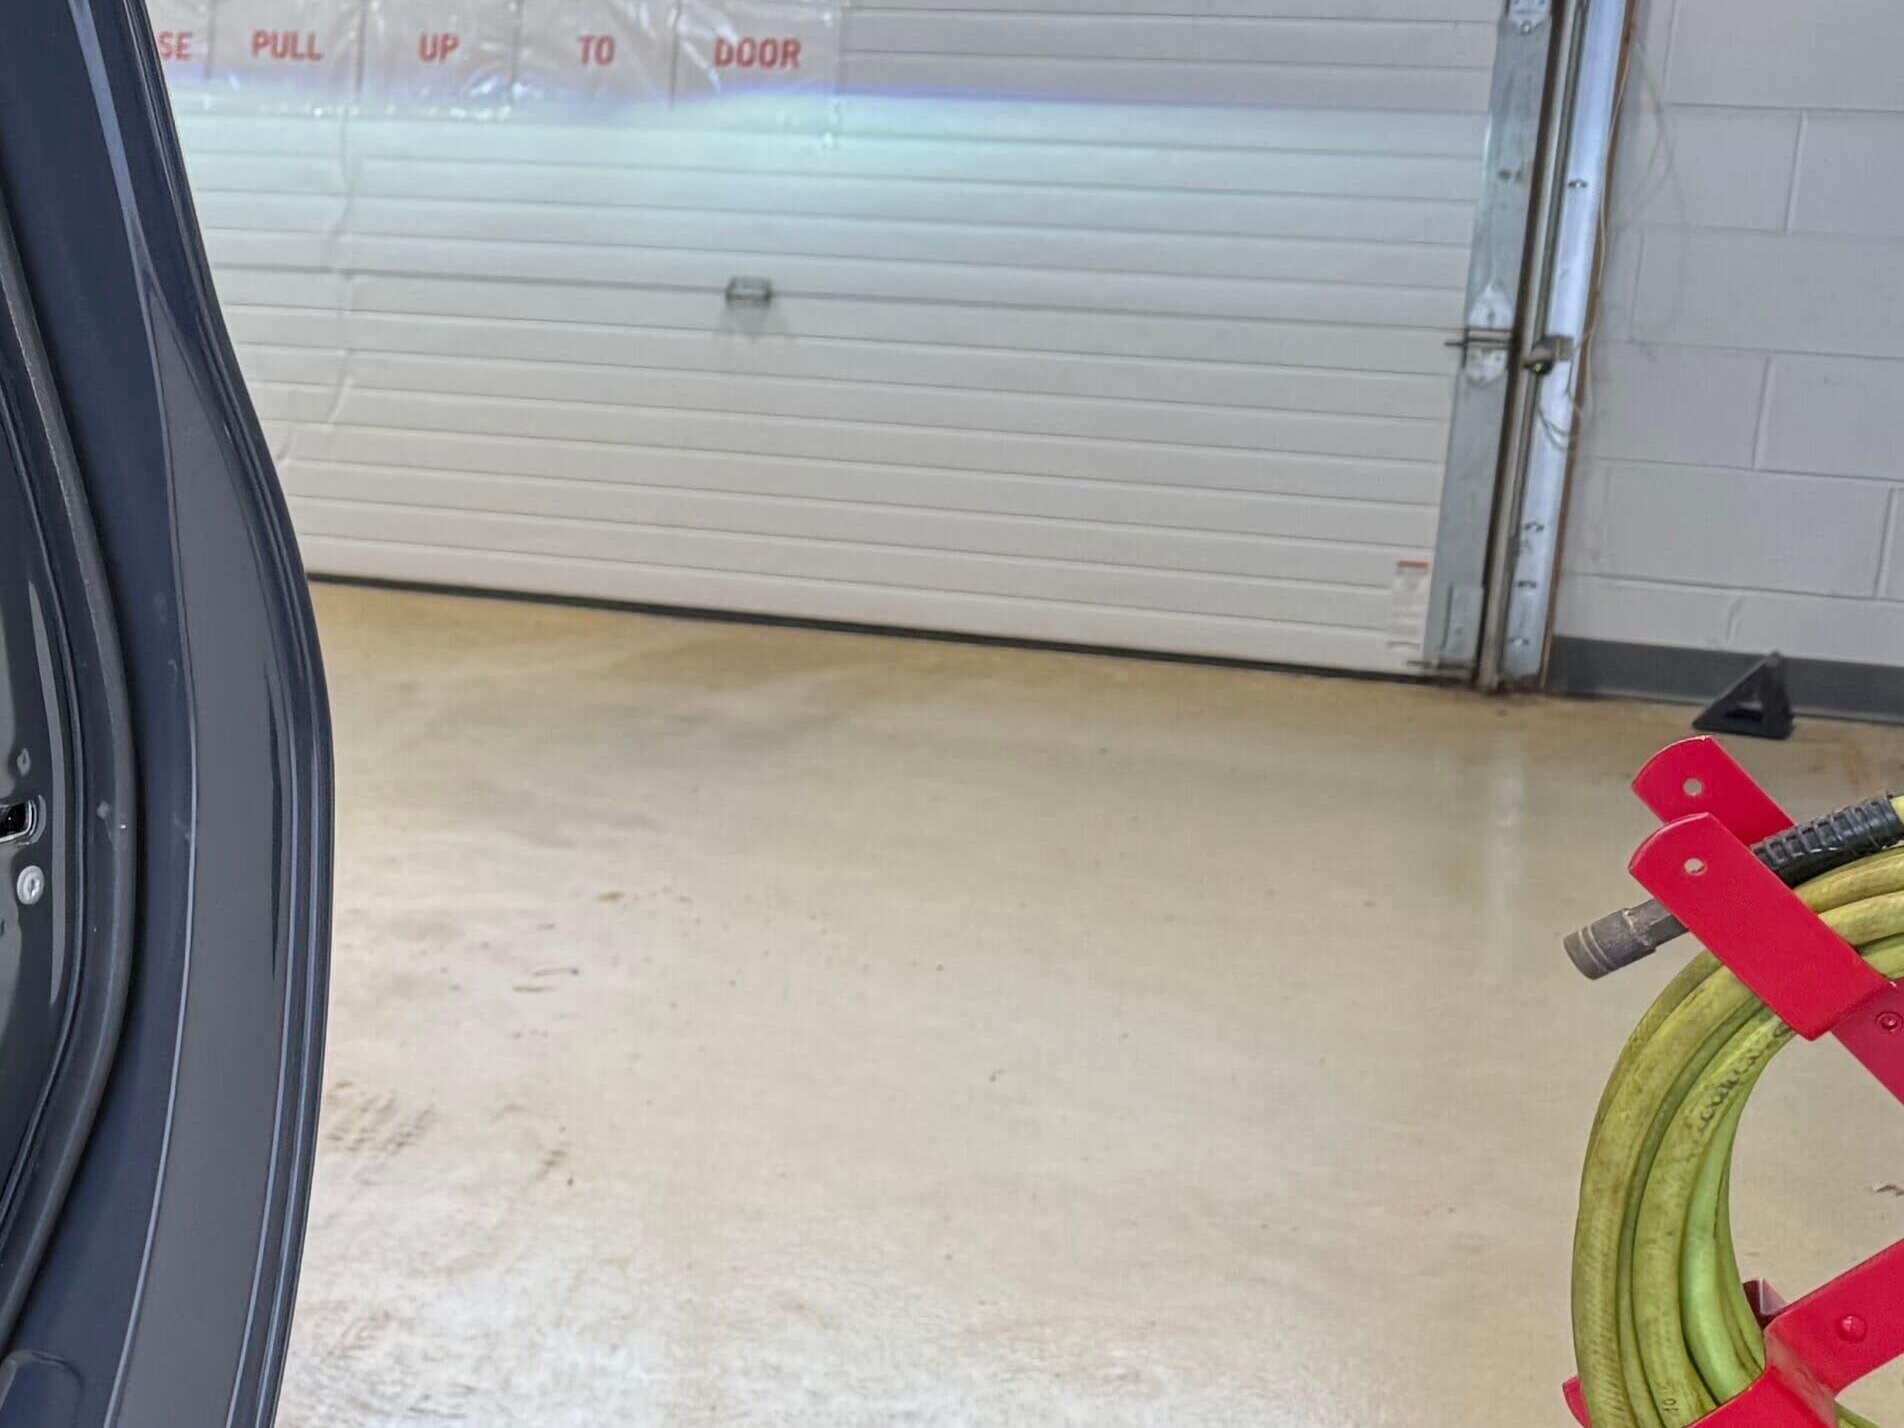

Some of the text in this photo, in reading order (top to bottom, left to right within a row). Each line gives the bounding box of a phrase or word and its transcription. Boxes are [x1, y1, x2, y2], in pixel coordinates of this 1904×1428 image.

[251, 30, 323, 61] PULL
[417, 32, 460, 62] UP
[578, 34, 616, 66] TO
[713, 36, 801, 69] DOOR
